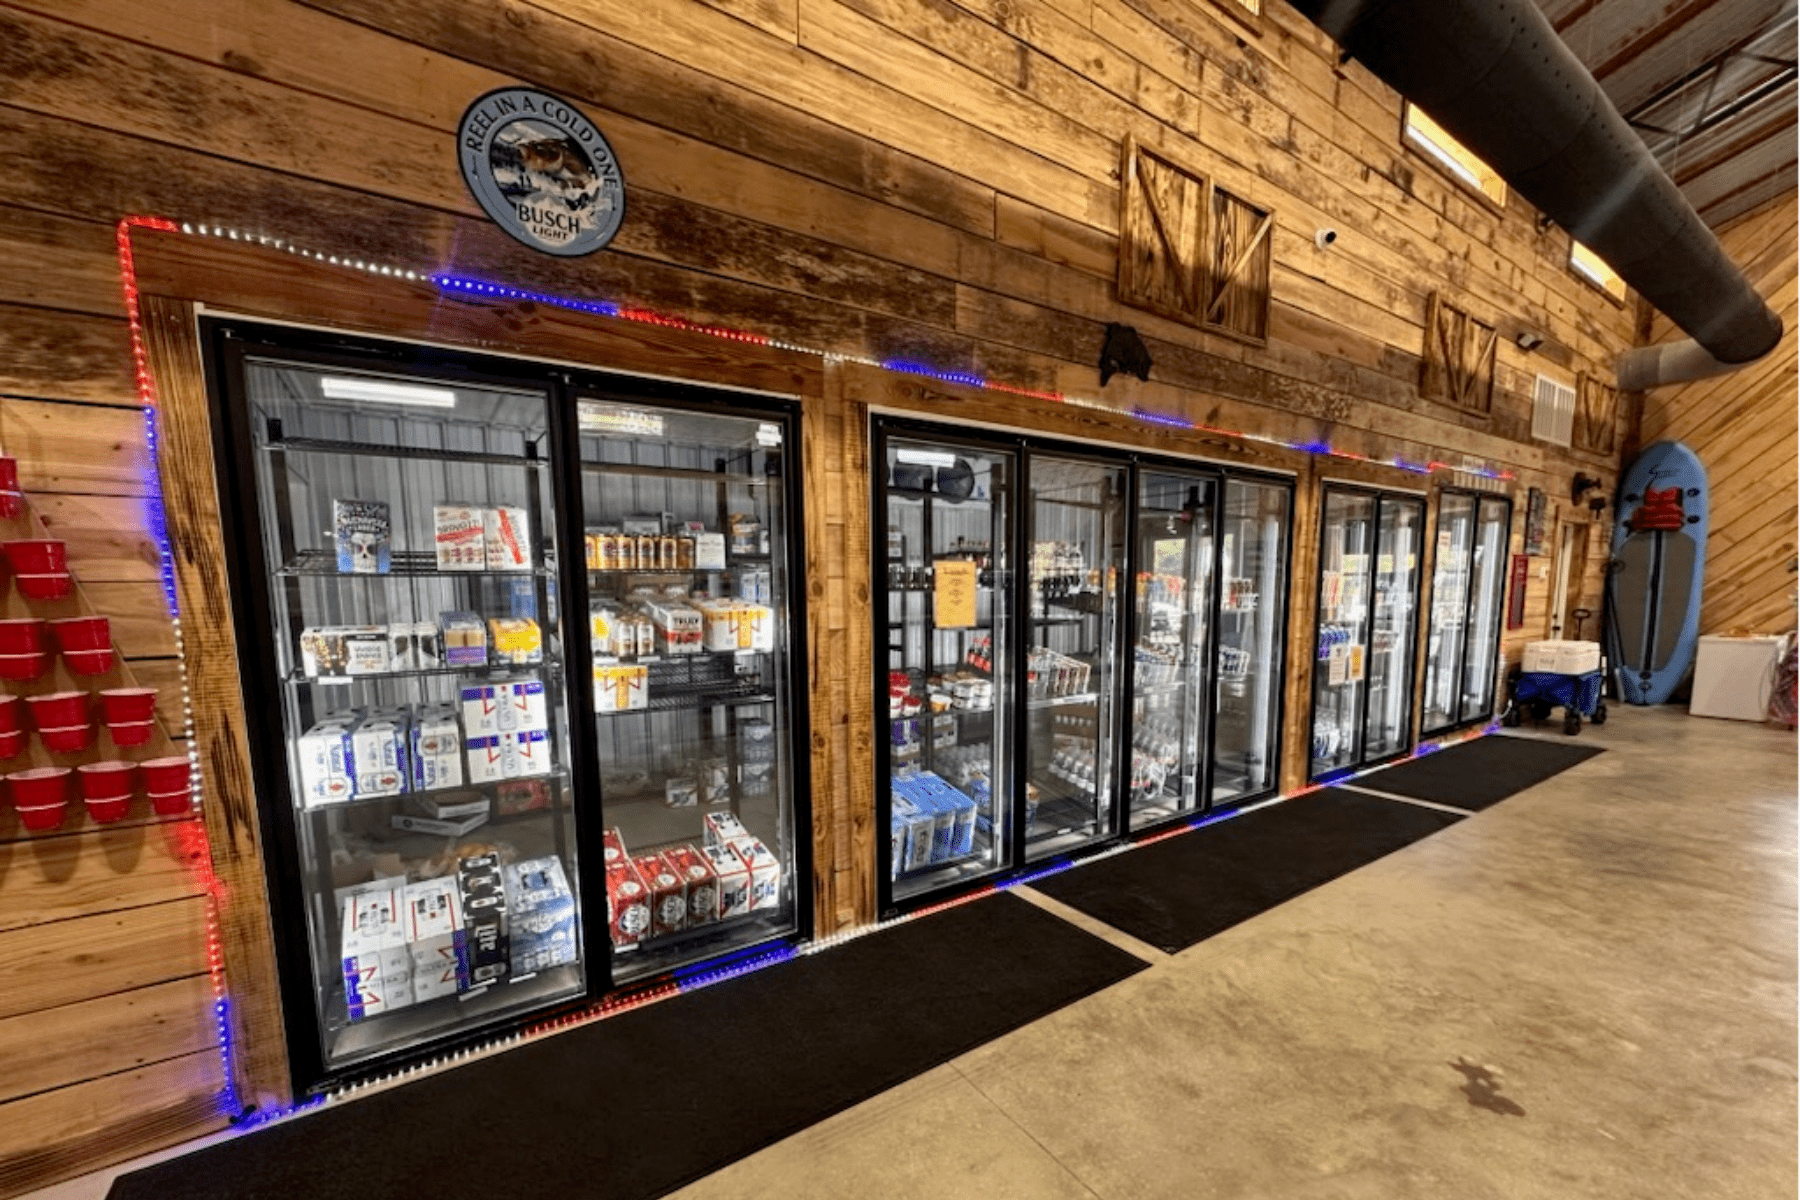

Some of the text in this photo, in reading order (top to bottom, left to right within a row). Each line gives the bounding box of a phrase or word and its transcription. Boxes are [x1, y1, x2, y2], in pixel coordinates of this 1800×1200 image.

[466, 96, 618, 190] REEL IN A COLD ONE
[518, 204, 580, 233] BUSCH
[532, 226, 569, 241] LIGHT
